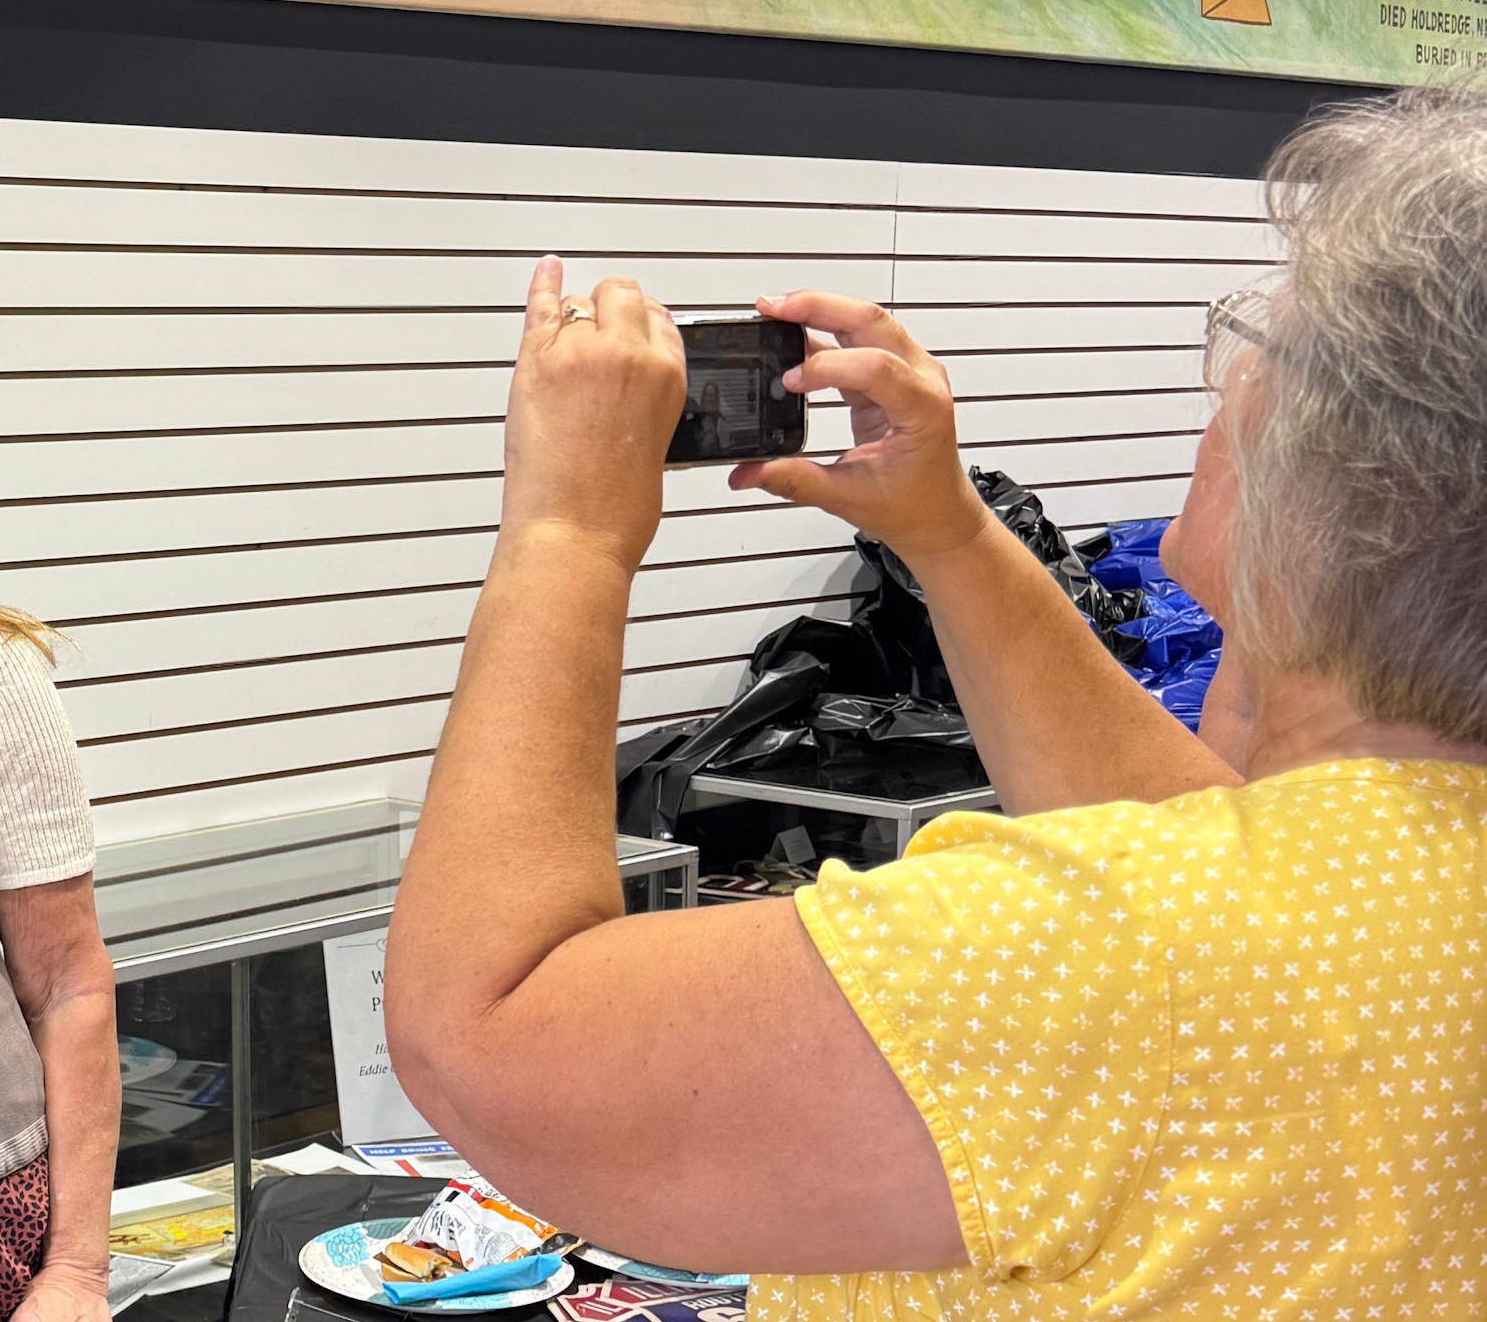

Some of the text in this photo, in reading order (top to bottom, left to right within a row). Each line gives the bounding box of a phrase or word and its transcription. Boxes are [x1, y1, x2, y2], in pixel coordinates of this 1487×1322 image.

[1380, 4, 1407, 28] DIED
[359, 1065, 389, 1077] Eddie
[681, 1290, 745, 1310] ROUT
